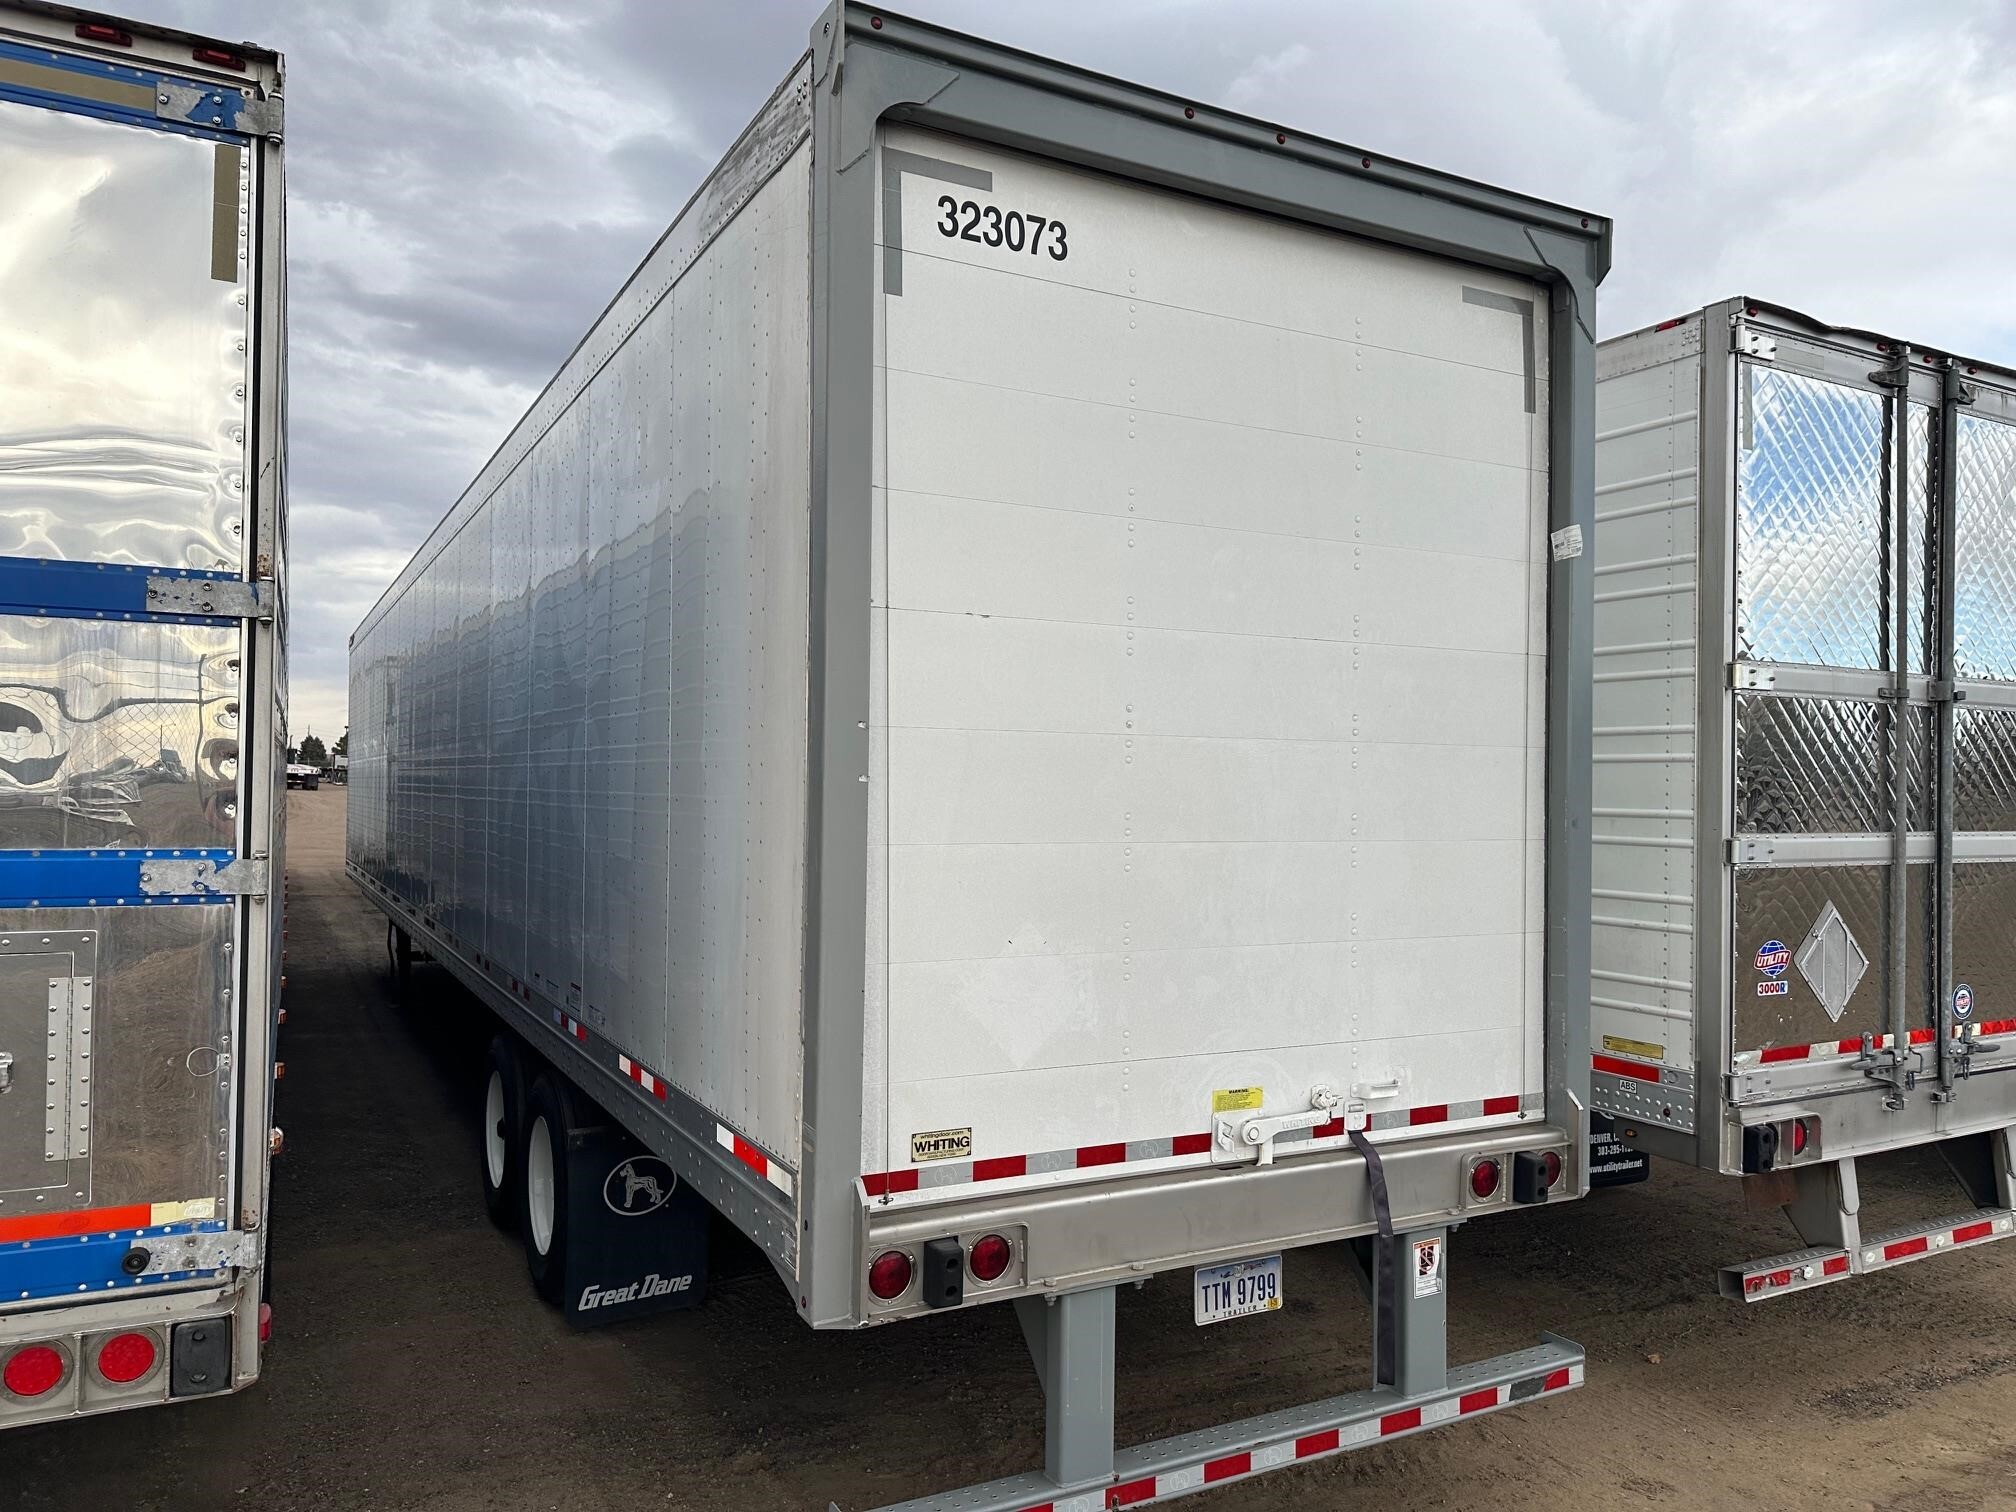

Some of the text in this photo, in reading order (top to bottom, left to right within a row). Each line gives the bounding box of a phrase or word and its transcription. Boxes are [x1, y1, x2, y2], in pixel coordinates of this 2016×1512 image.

[937, 195, 1068, 261] 323073
[1756, 952, 1789, 967] UTILITY
[1758, 982, 1786, 994] 3000R
[1621, 1081, 1636, 1091] ABS
[920, 1130, 964, 1139] whitingdoor.com
[914, 1136, 970, 1153] WHITING
[578, 1273, 693, 1311] Great Dane
[1202, 1272, 1276, 1313] TTM 9799
[1223, 1305, 1258, 1318] TRAILER
